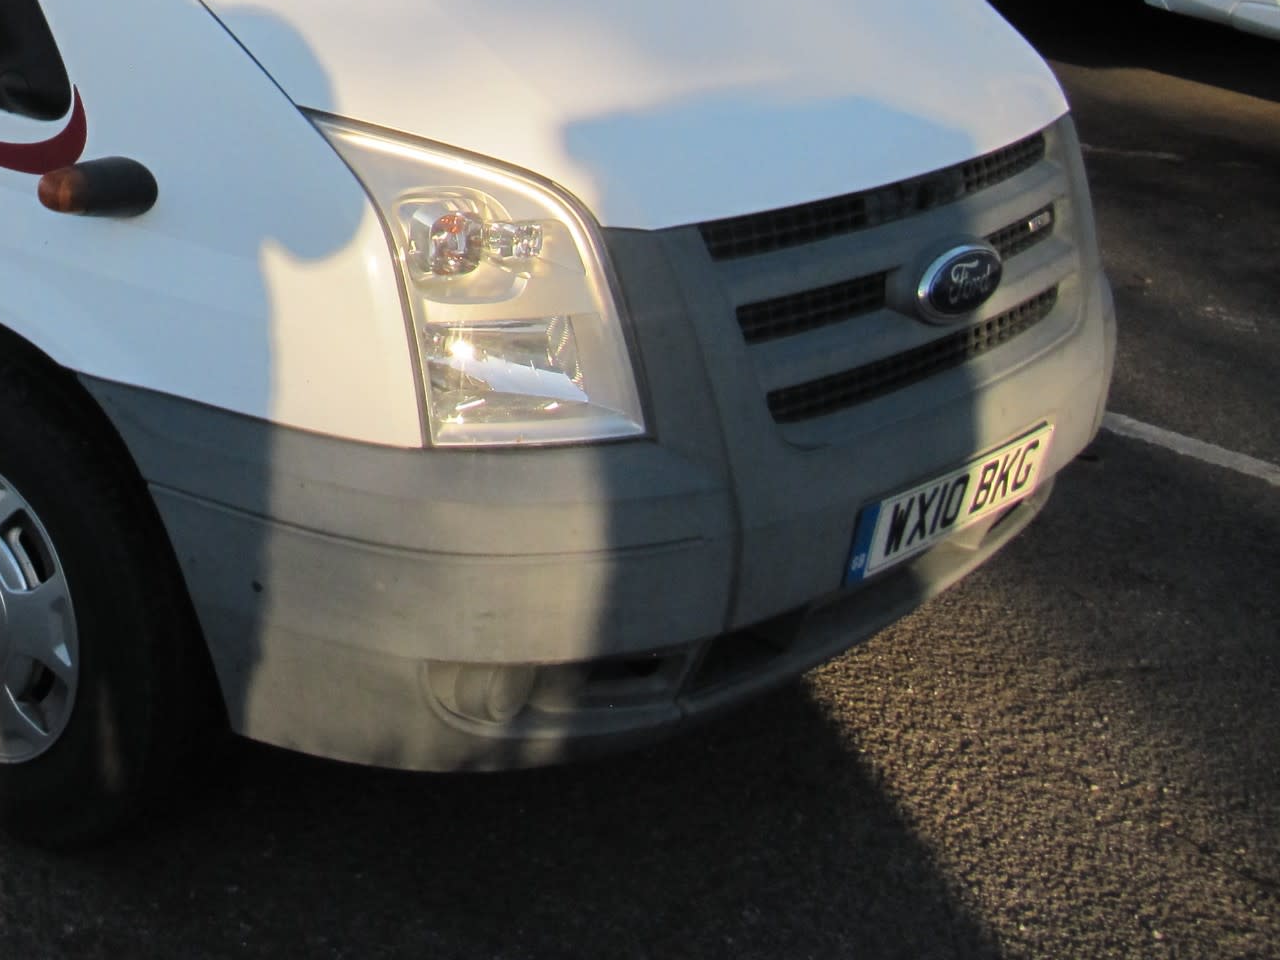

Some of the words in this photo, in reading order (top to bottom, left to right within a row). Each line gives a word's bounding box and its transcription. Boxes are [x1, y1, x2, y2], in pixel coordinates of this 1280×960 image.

[948, 258, 991, 305] Ford
[884, 473, 970, 557] WX10
[968, 439, 1040, 516] BKG
